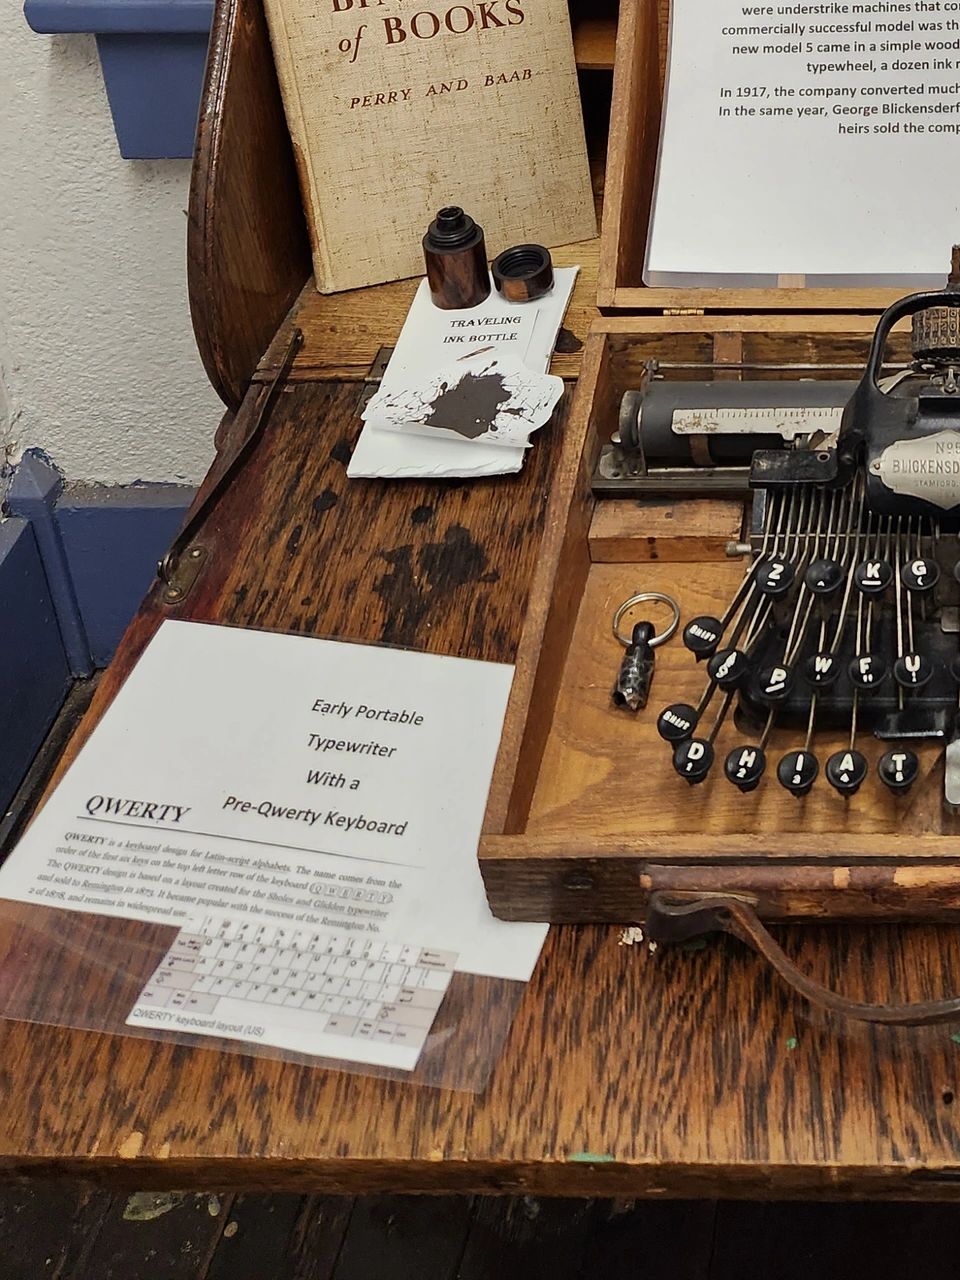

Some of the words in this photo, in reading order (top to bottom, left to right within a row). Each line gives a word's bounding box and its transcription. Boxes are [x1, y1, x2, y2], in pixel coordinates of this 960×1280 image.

[741, 6, 774, 16] were
[777, 2, 849, 15] understrike
[852, 1, 912, 14] machines
[914, 0, 941, 12] that
[338, 25, 368, 63] of
[349, 88, 411, 110] PERRY
[425, 79, 469, 97] AND
[484, 68, 534, 87] BAAB
[838, 122, 870, 135] heirs
[873, 121, 900, 134] sold
[903, 121, 925, 134] the
[450, 316, 521, 328] TRAVELING
[443, 335, 465, 343] INK
[469, 332, 518, 343] BOTTLE
[311, 699, 352, 718] Early
[355, 705, 424, 726] Portable
[307, 733, 397, 758] Typewriter
[687, 742, 704, 760] D
[738, 749, 756, 768] H
[839, 753, 855, 772] A
[891, 754, 907, 772] T
[306, 770, 346, 789] With
[349, 778, 360, 790] a
[85, 795, 192, 822] QWERTY
[222, 796, 322, 826] Pre-Qwerty
[323, 810, 409, 836] Keyboard
[64, 832, 107, 846] QWERTY
[125, 840, 161, 853] keyboard
[161, 844, 188, 857] design
[190, 848, 202, 858] for
[204, 850, 250, 867] Latin-script
[252, 857, 291, 872] alphabets.
[296, 865, 311, 875] The
[313, 869, 336, 880] name
[338, 873, 363, 884] comes
[366, 876, 386, 887] from
[388, 879, 402, 889] the
[132, 1008, 175, 1022] QWERTY
[175, 1013, 215, 1031] keyboard
[216, 1022, 243, 1035] layout
[243, 1024, 265, 1037] (US)
